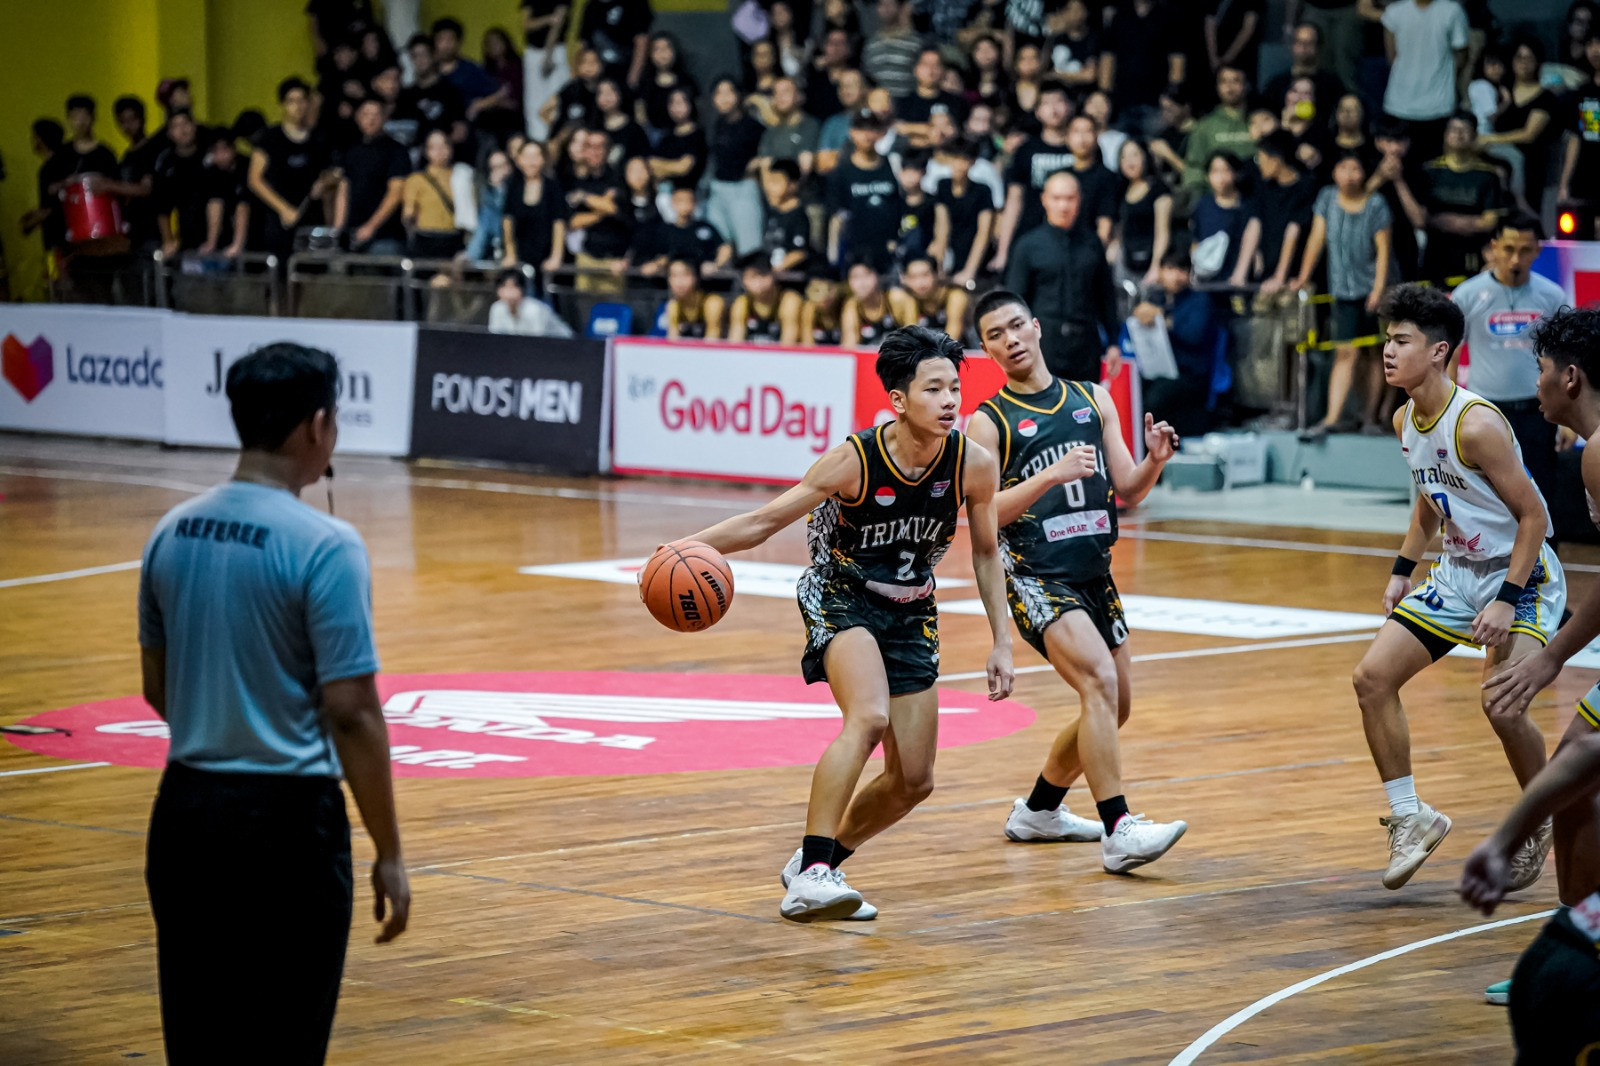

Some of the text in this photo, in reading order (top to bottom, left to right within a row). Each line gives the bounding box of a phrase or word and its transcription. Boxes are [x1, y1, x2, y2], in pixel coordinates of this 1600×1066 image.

[519, 378, 583, 424] MEN
[1064, 479, 1086, 508] 0
[175, 518, 270, 550] REFEREE
[1049, 529, 1065, 538] One
[896, 551, 916, 581] 2
[679, 590, 702, 620] DBL
